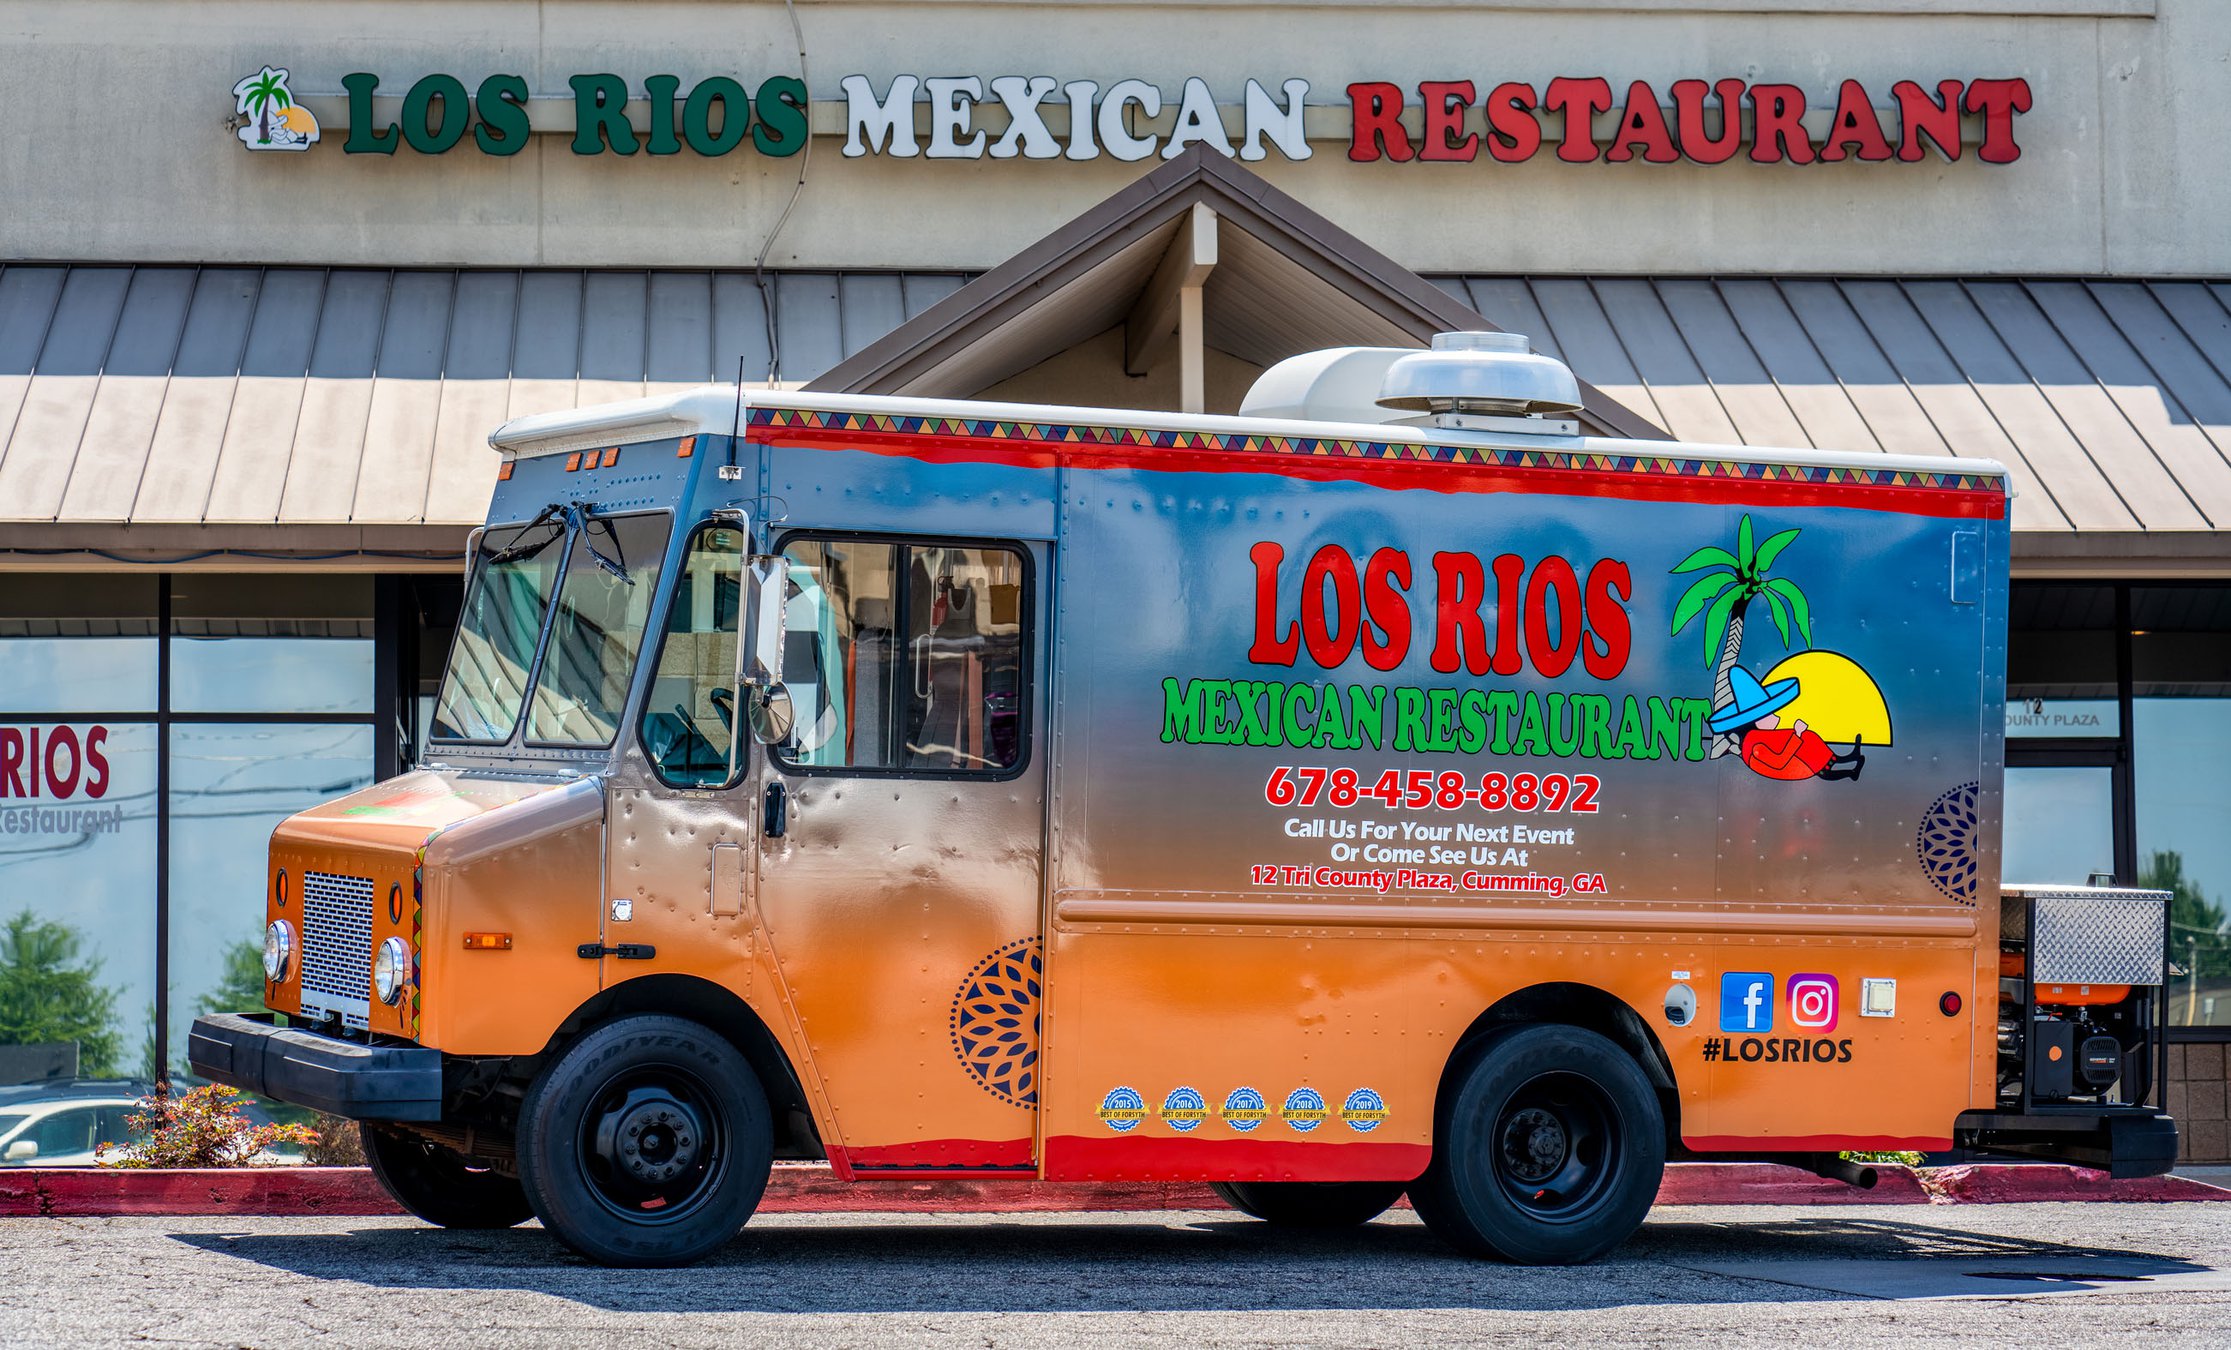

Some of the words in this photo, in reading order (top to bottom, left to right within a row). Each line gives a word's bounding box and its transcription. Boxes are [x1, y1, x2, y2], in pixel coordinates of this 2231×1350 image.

[341, 73, 531, 155] LOS
[568, 73, 809, 157] RIOS
[840, 74, 1314, 162] MEXICAN
[1346, 76, 2032, 165] RESTAURANT
[1248, 541, 1412, 672] LOS
[1430, 551, 1632, 681] RIOS
[1160, 677, 1387, 751] MEXICAN
[1393, 686, 1712, 762] RESTAURANT
[2054, 714, 2100, 726] PLAZA
[0, 724, 110, 800] RIOS
[1264, 766, 1601, 814] 678-458-8892
[0, 803, 122, 834] estaurant
[1284, 818, 1325, 838] Call
[1328, 820, 1356, 839] Us
[1361, 820, 1397, 840] For
[1400, 822, 1452, 841] Your
[1456, 823, 1509, 844] Next
[1512, 825, 1575, 845] Event
[1330, 843, 1360, 862] Or
[1363, 844, 1426, 864] Come
[1429, 845, 1467, 865] See
[1470, 847, 1497, 866] Us
[1500, 848, 1529, 867] At
[1251, 865, 1278, 886] 12
[1281, 865, 1312, 887] Tri
[1313, 867, 1395, 894] County
[1396, 869, 1460, 892] Plaza,
[1461, 870, 1570, 899] Cumming,
[1571, 872, 1608, 893] GA
[1702, 1038, 1853, 1063] #LOSRIOS
[1114, 1100, 1131, 1109] 2015
[1175, 1100, 1193, 1109] 2016
[1236, 1100, 1253, 1109] 2017
[1296, 1100, 1313, 1109] 2018
[1355, 1101, 1372, 1110] 2019
